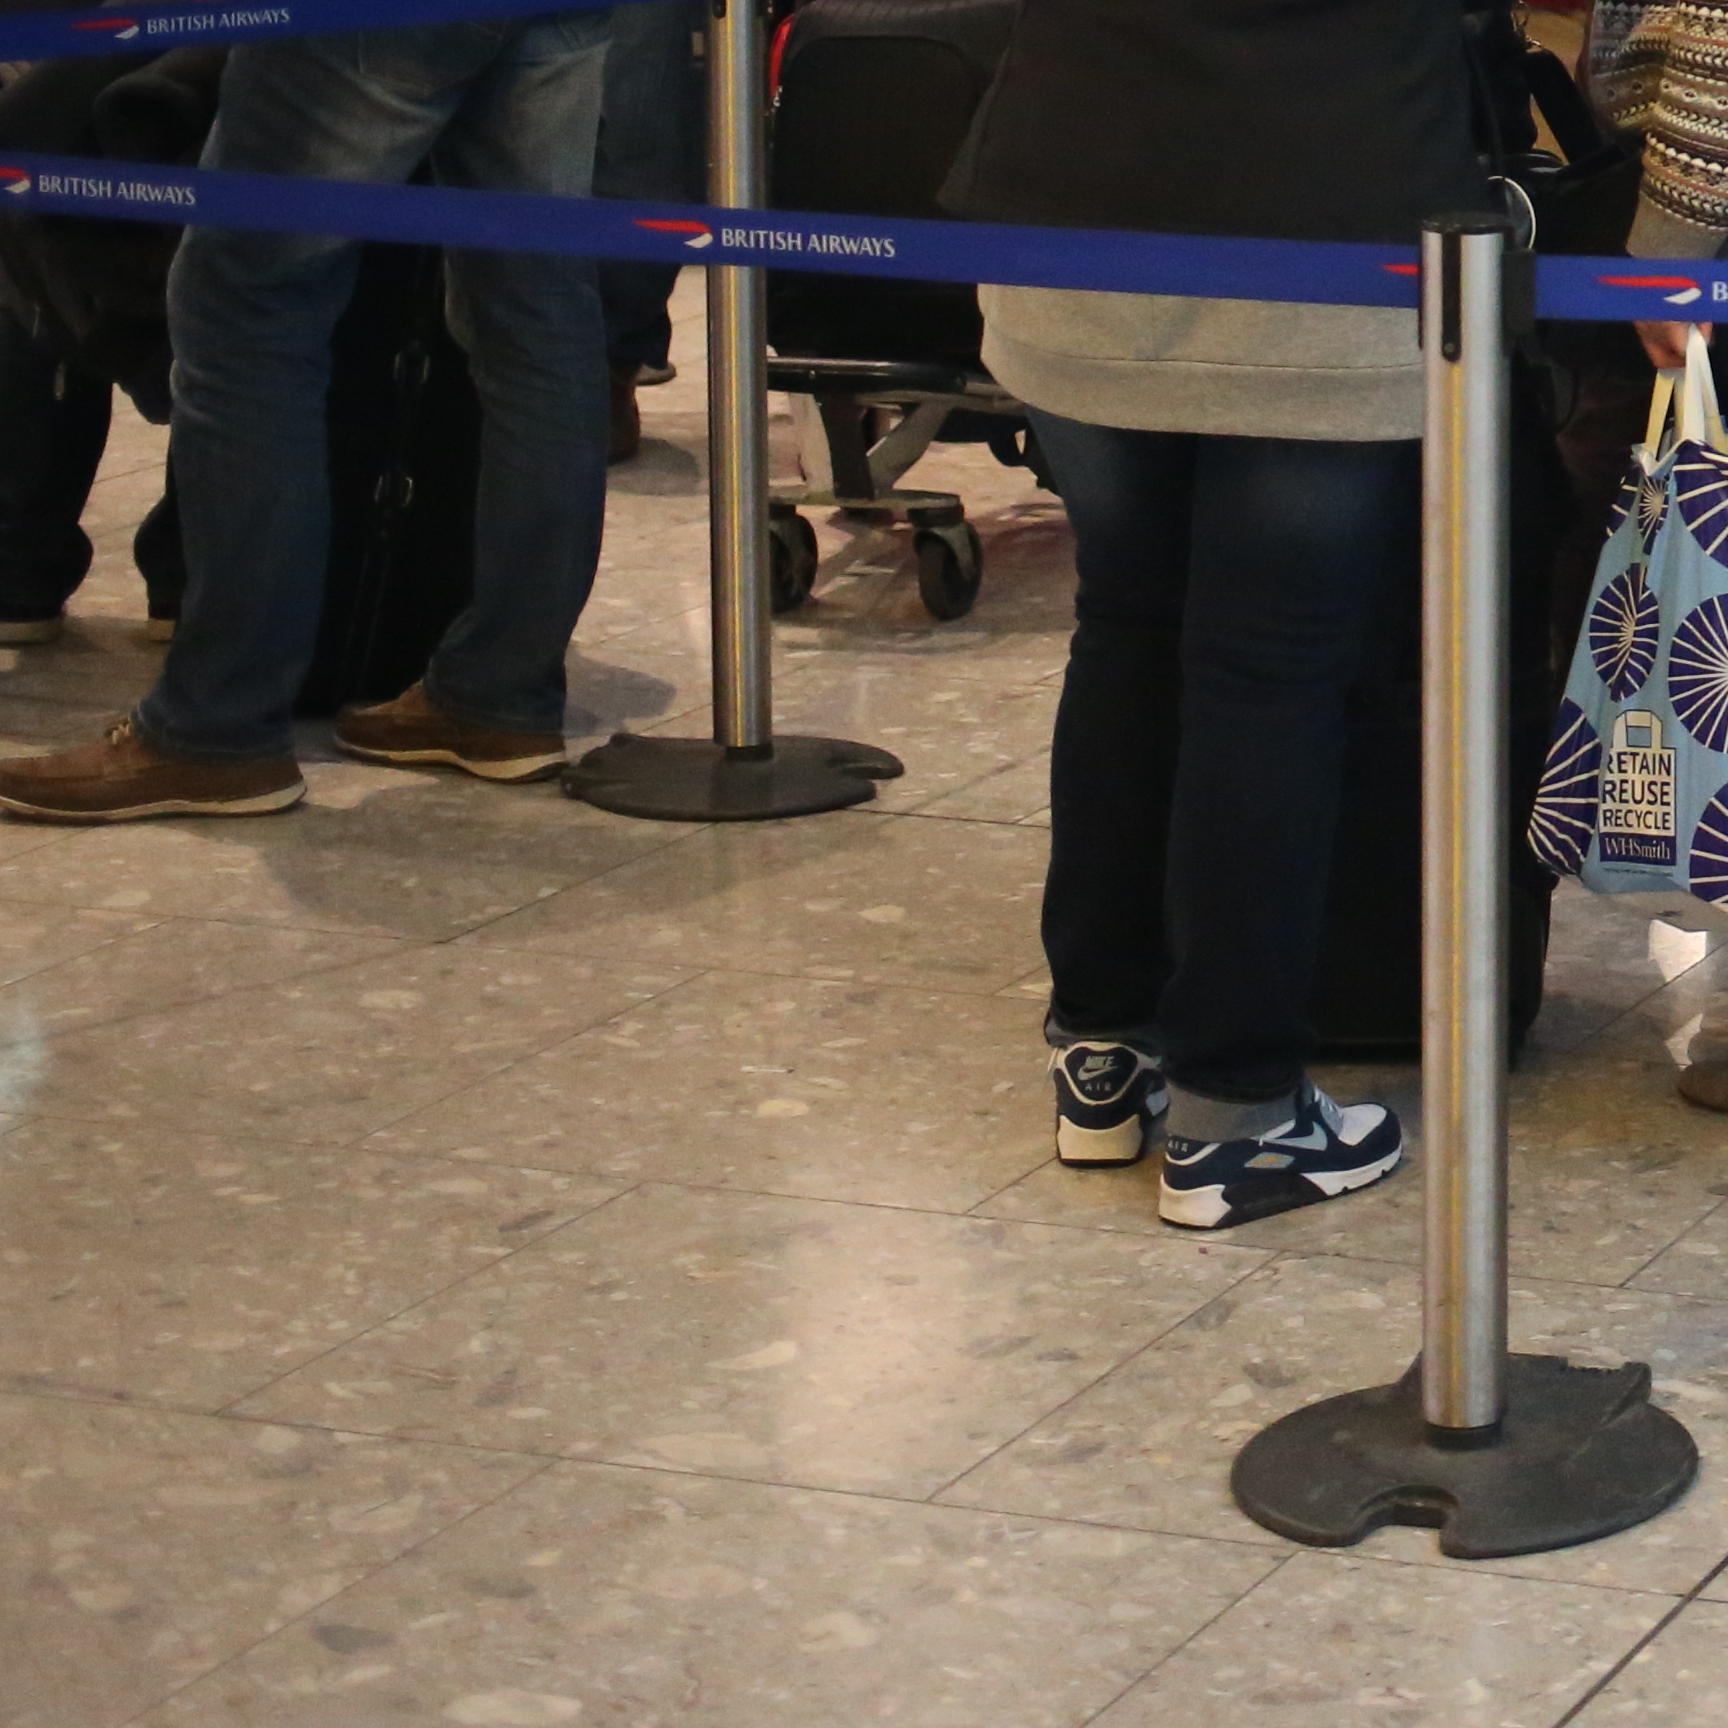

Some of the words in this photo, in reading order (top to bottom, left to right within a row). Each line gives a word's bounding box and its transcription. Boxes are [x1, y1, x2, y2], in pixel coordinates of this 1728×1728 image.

[147, 14, 215, 34] BRITISH
[219, 7, 290, 28] AIRWAYS
[38, 174, 112, 198] BRITISH
[117, 181, 196, 205] AIRWAYS
[721, 227, 802, 252] BRITISH
[807, 233, 896, 258] AIRWAYS
[1601, 778, 1671, 807] REUSE
[1602, 808, 1671, 831] RECYCLE
[1604, 837, 1670, 860] WHSmith
[1084, 1055, 1116, 1070] NIKE
[1084, 1082, 1112, 1092] AIR
